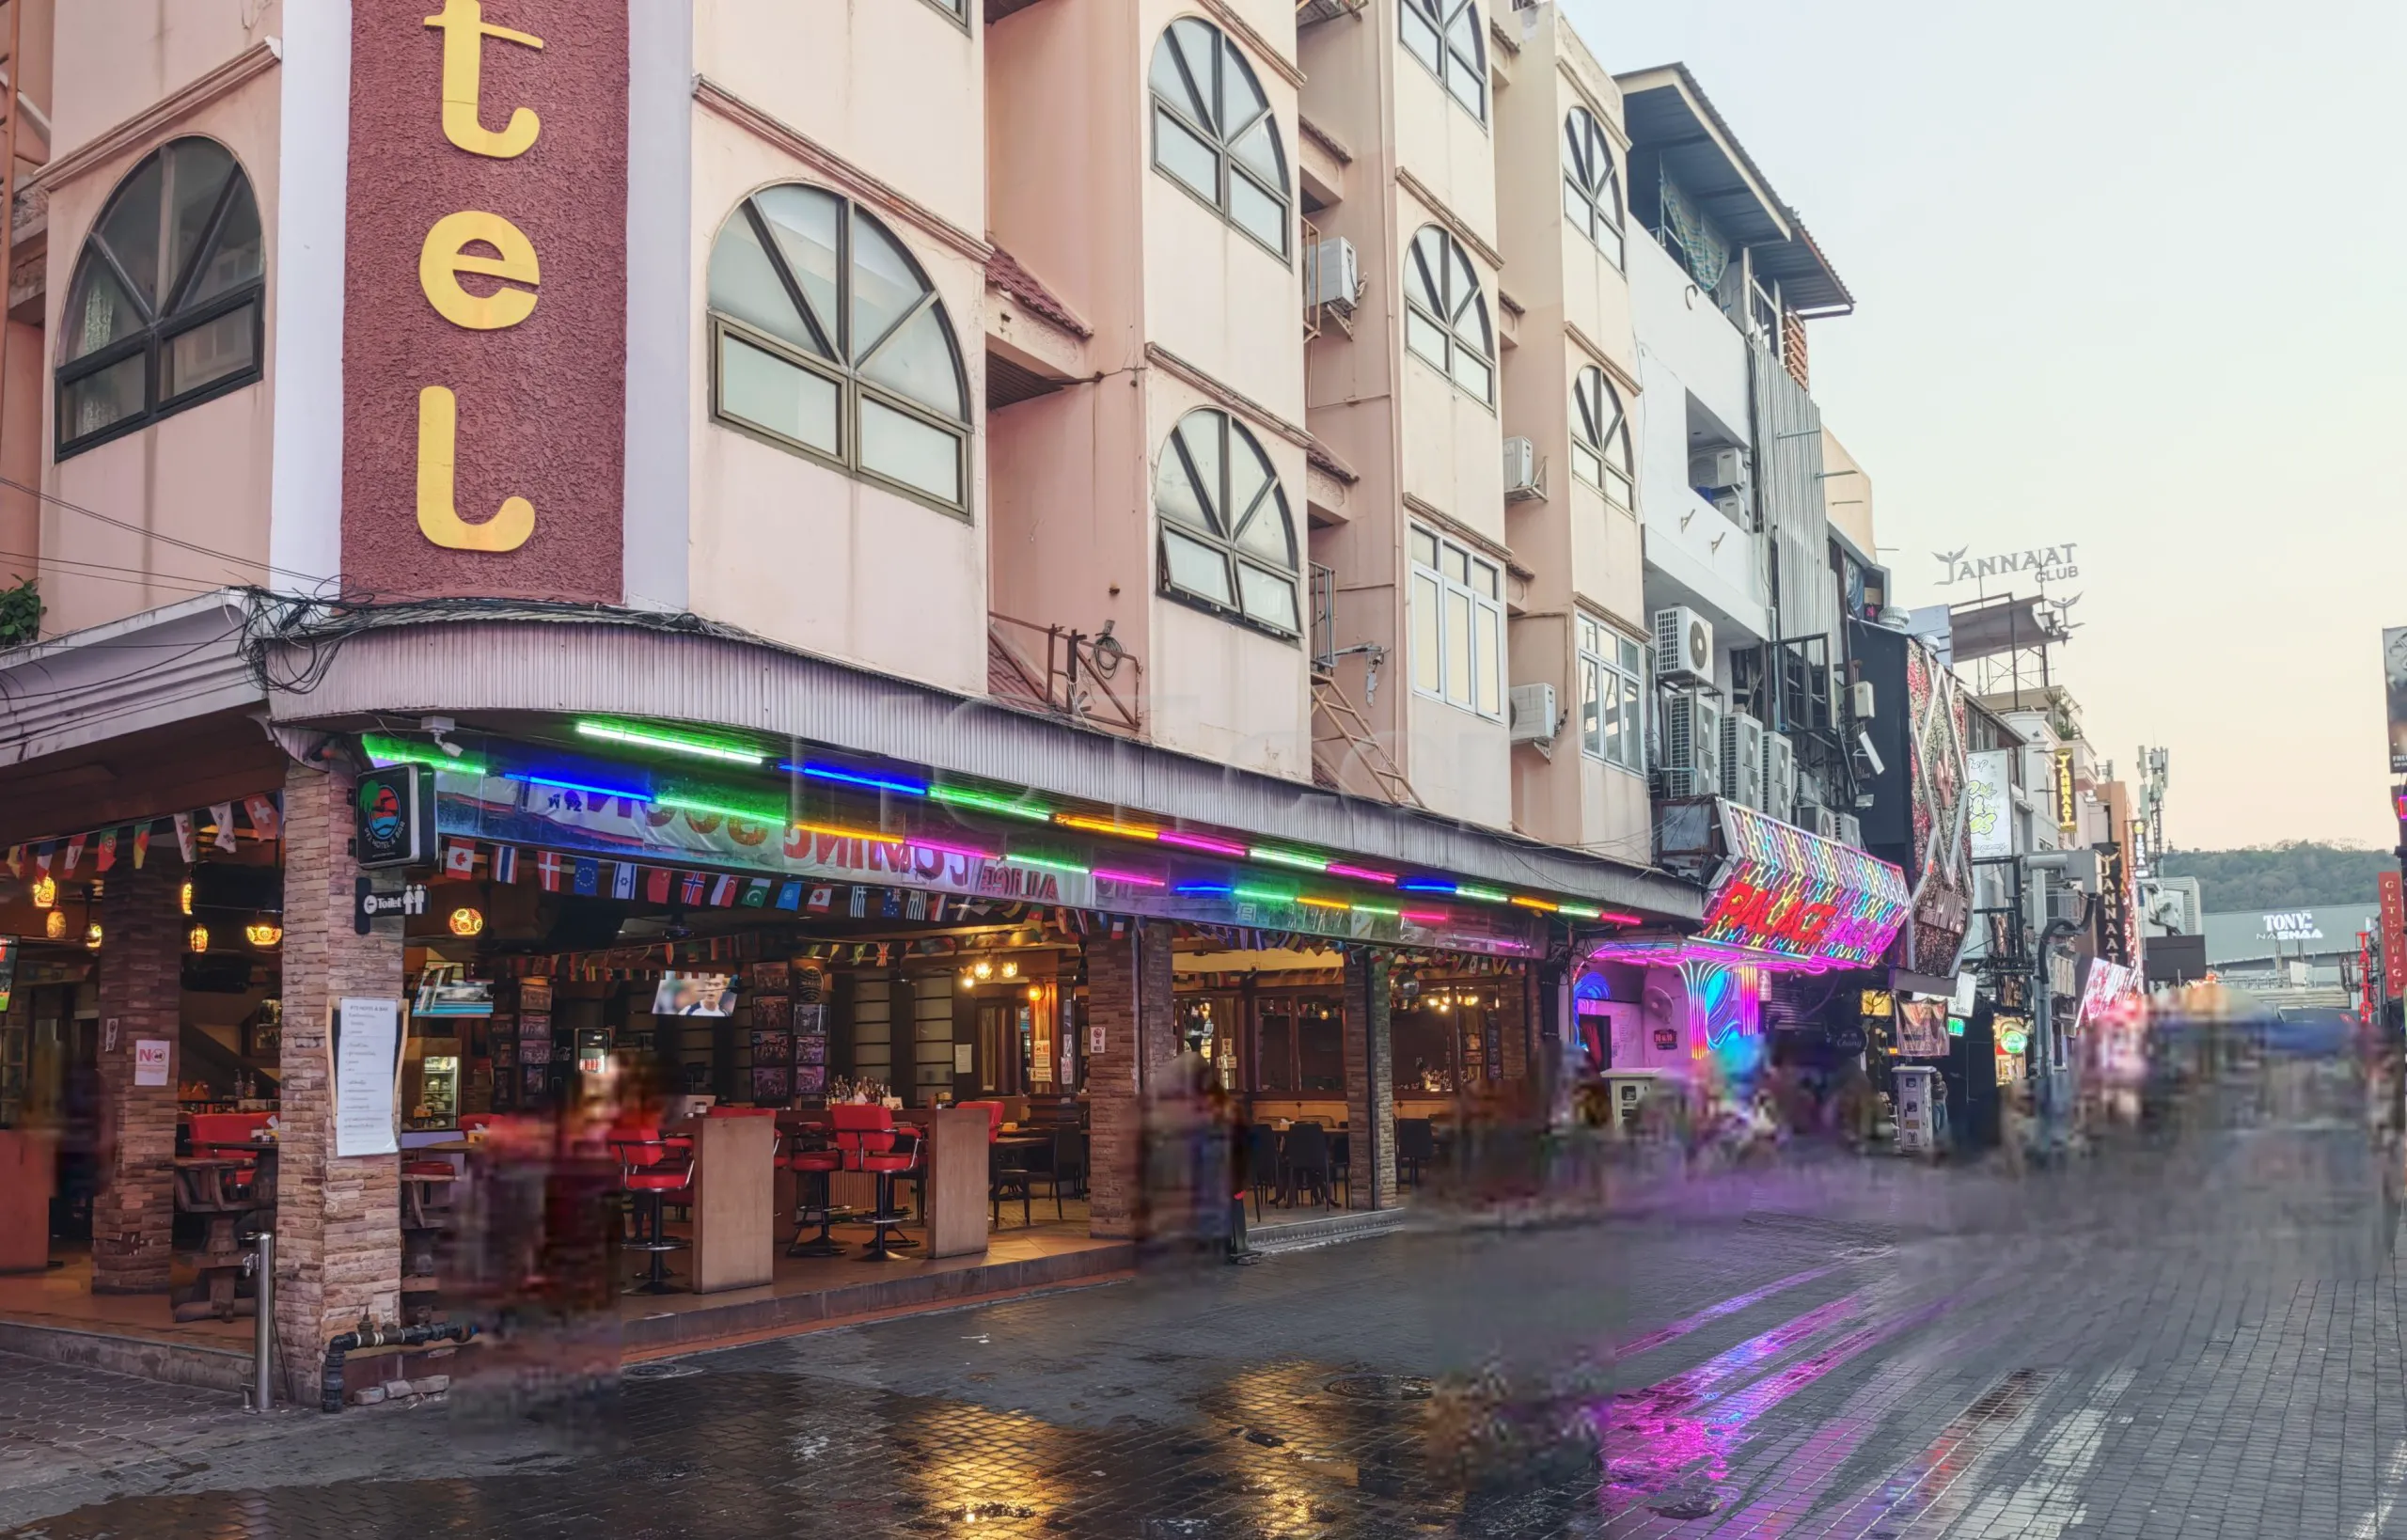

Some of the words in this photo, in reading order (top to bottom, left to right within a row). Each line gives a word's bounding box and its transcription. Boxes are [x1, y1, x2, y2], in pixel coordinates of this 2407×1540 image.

[1931, 543, 2078, 585] JANNAAT
[2035, 565, 2079, 583] CLUB
[377, 897, 401, 908] Toilet
